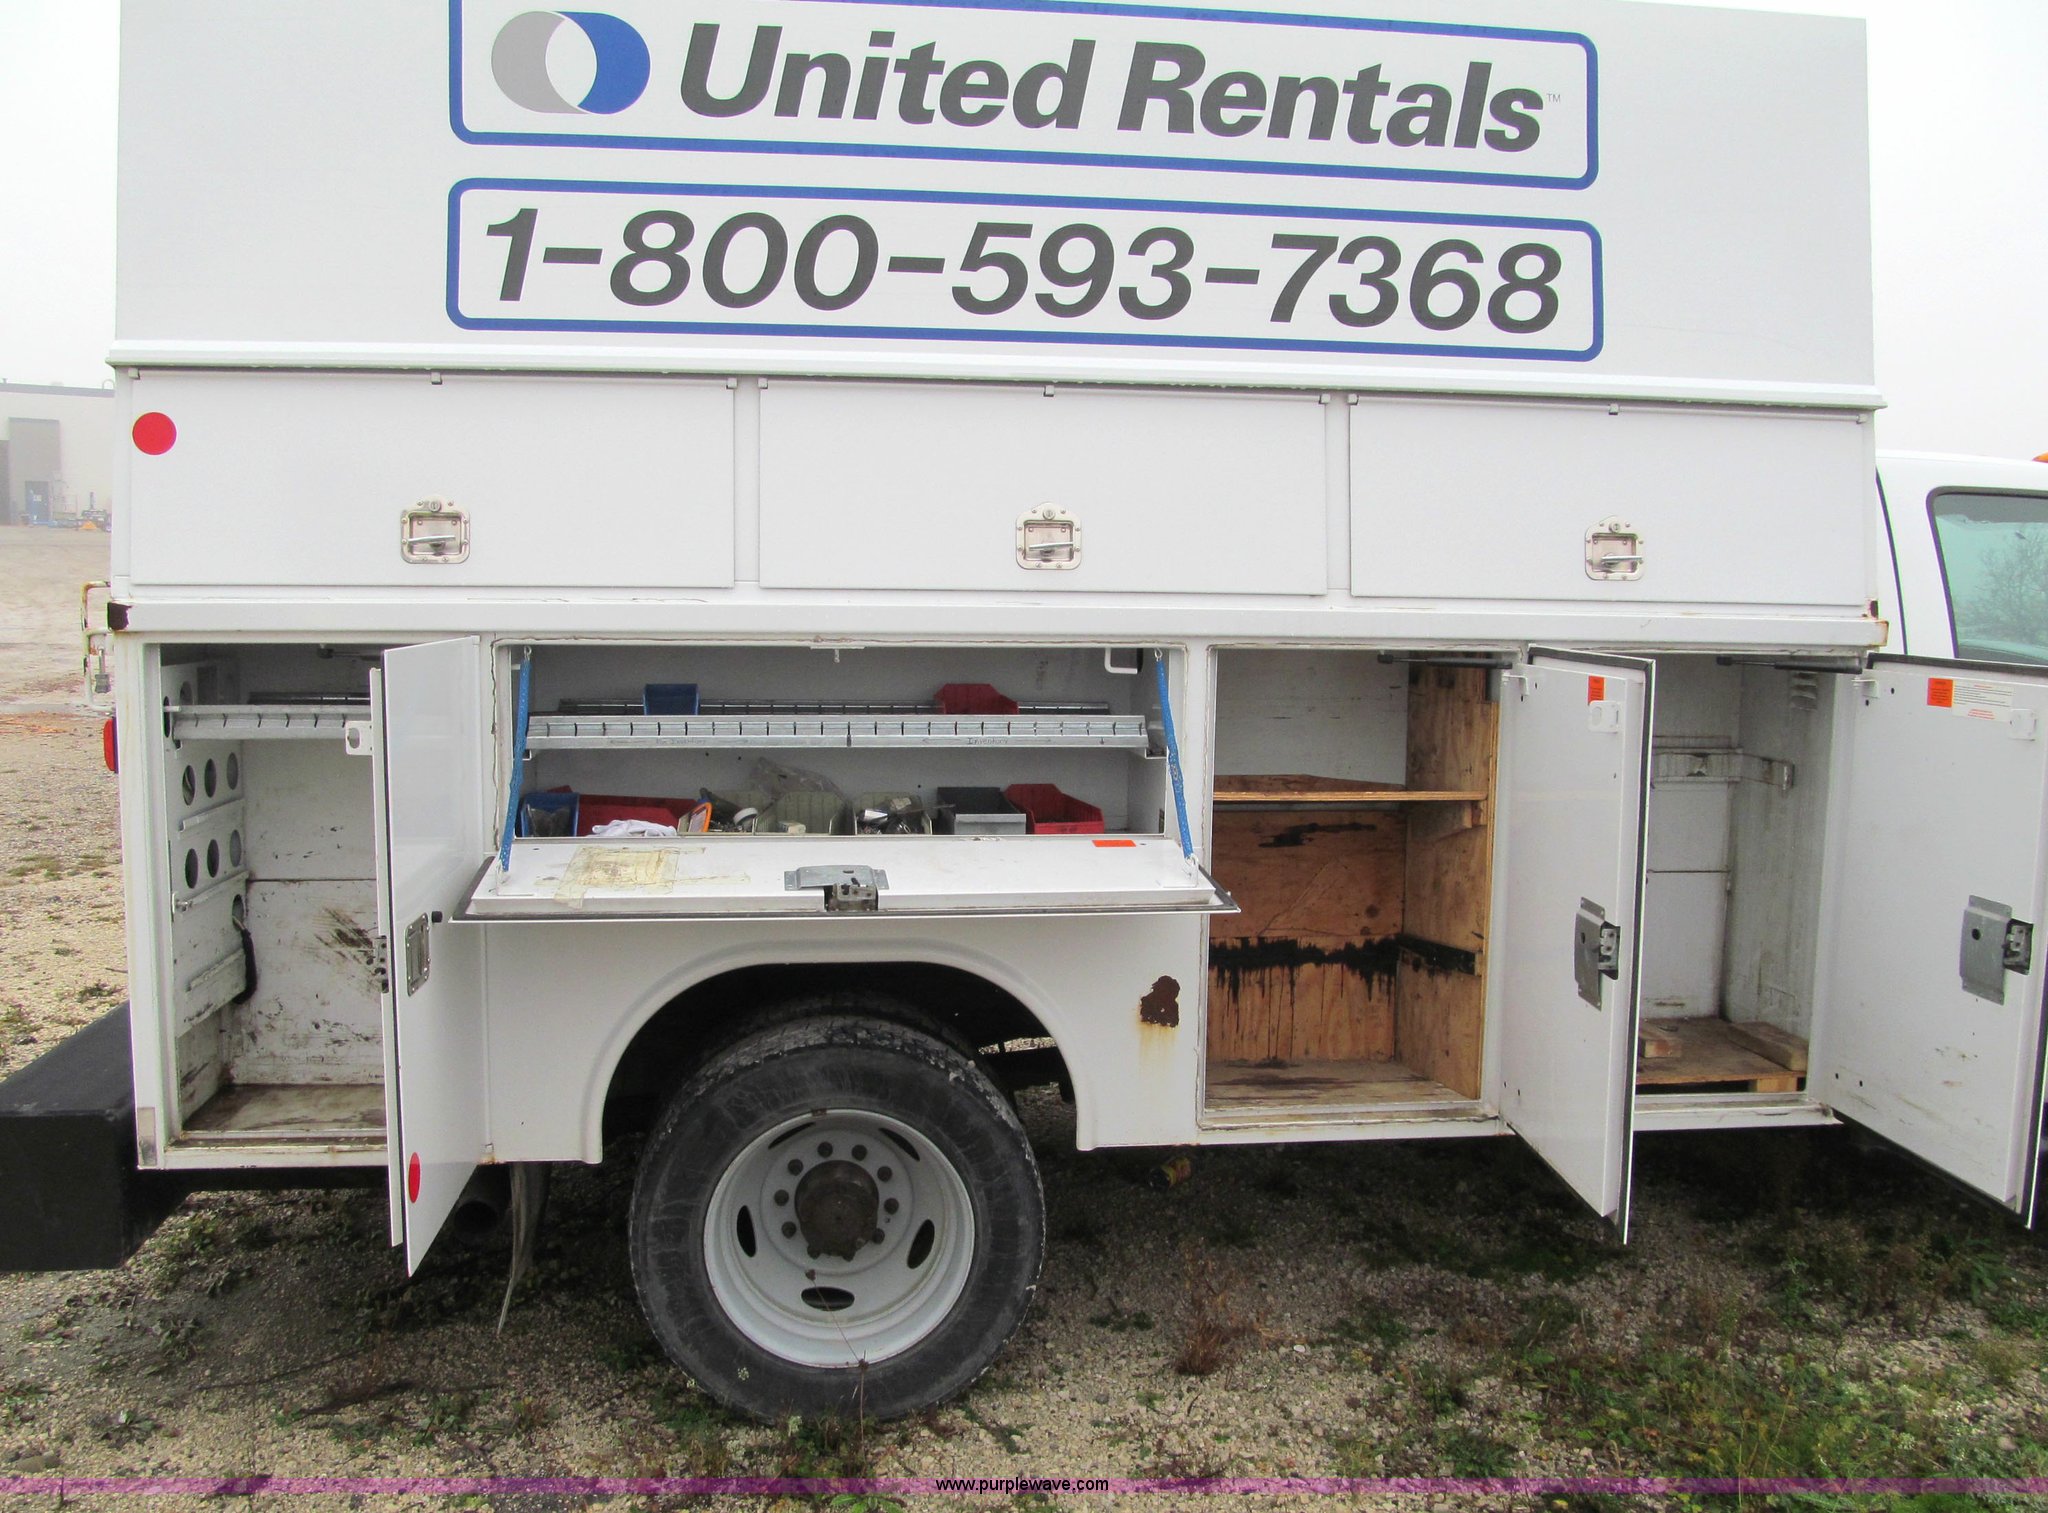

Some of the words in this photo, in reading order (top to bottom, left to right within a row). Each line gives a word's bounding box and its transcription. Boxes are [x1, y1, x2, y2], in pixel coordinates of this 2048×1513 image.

[680, 22, 1096, 129] United
[1117, 41, 1544, 152] Rentals
[486, 208, 1562, 334] 1-800-593-7368
